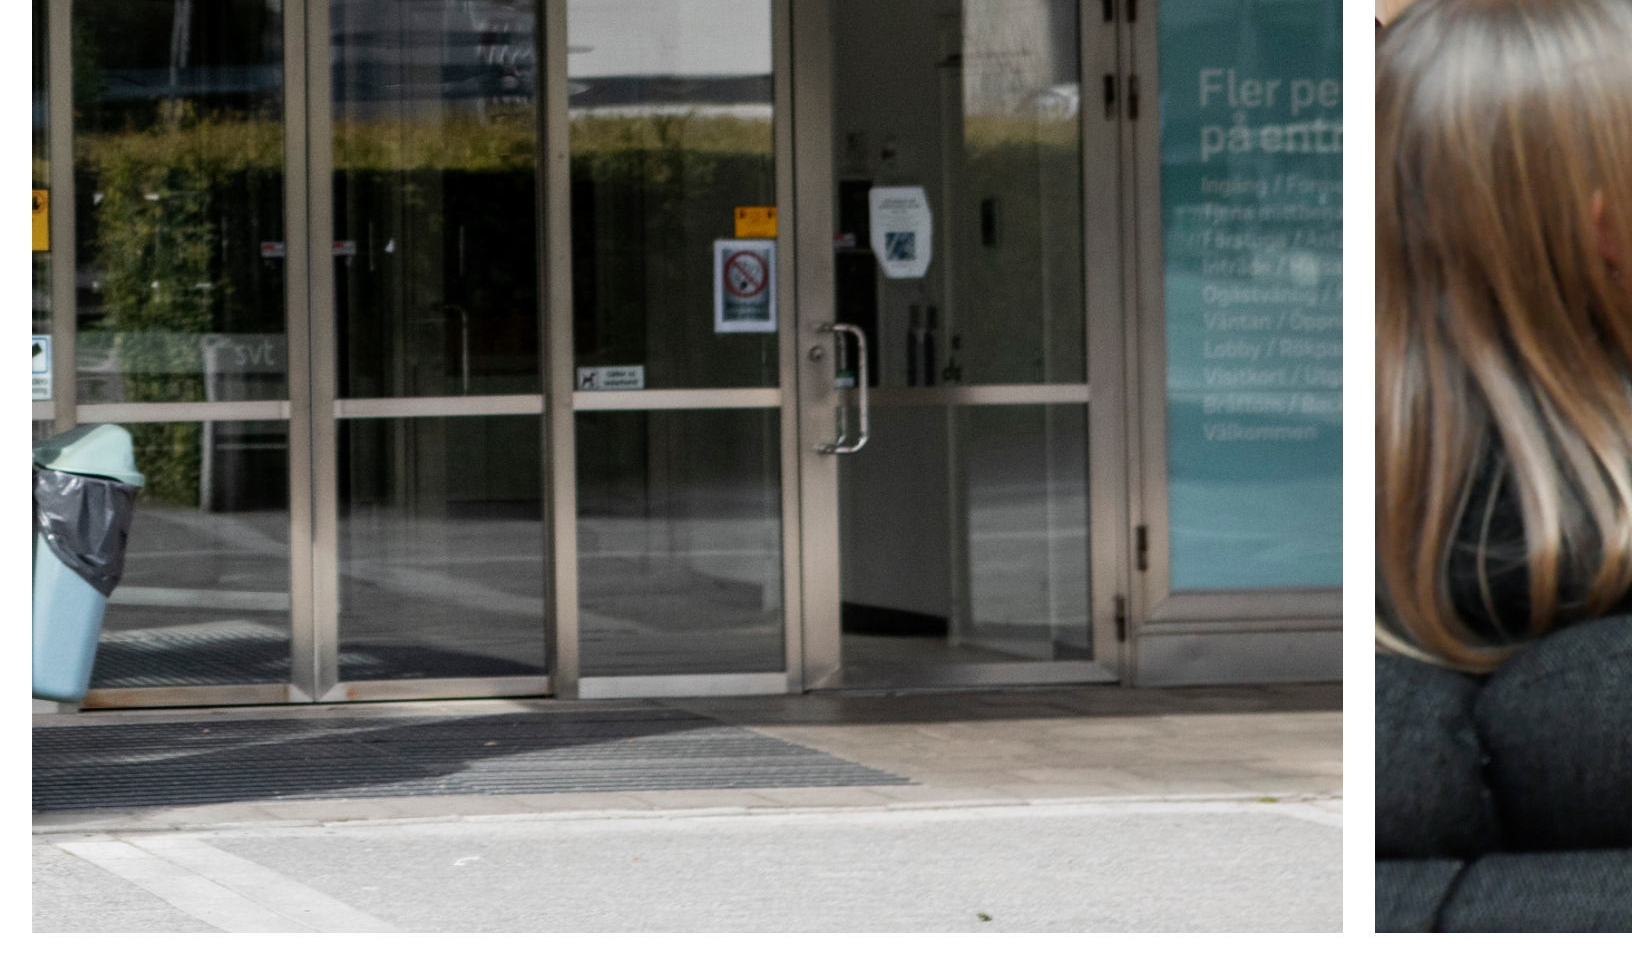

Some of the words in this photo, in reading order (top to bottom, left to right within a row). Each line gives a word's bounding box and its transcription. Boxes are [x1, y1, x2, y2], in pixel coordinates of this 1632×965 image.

[1199, 67, 1281, 108] Fler
[1290, 78, 1341, 117] pe
[1200, 110, 1250, 163] på
[234, 339, 275, 366] svt
[1203, 339, 1261, 362] Lobby
[1202, 422, 1318, 442] Välkommen
